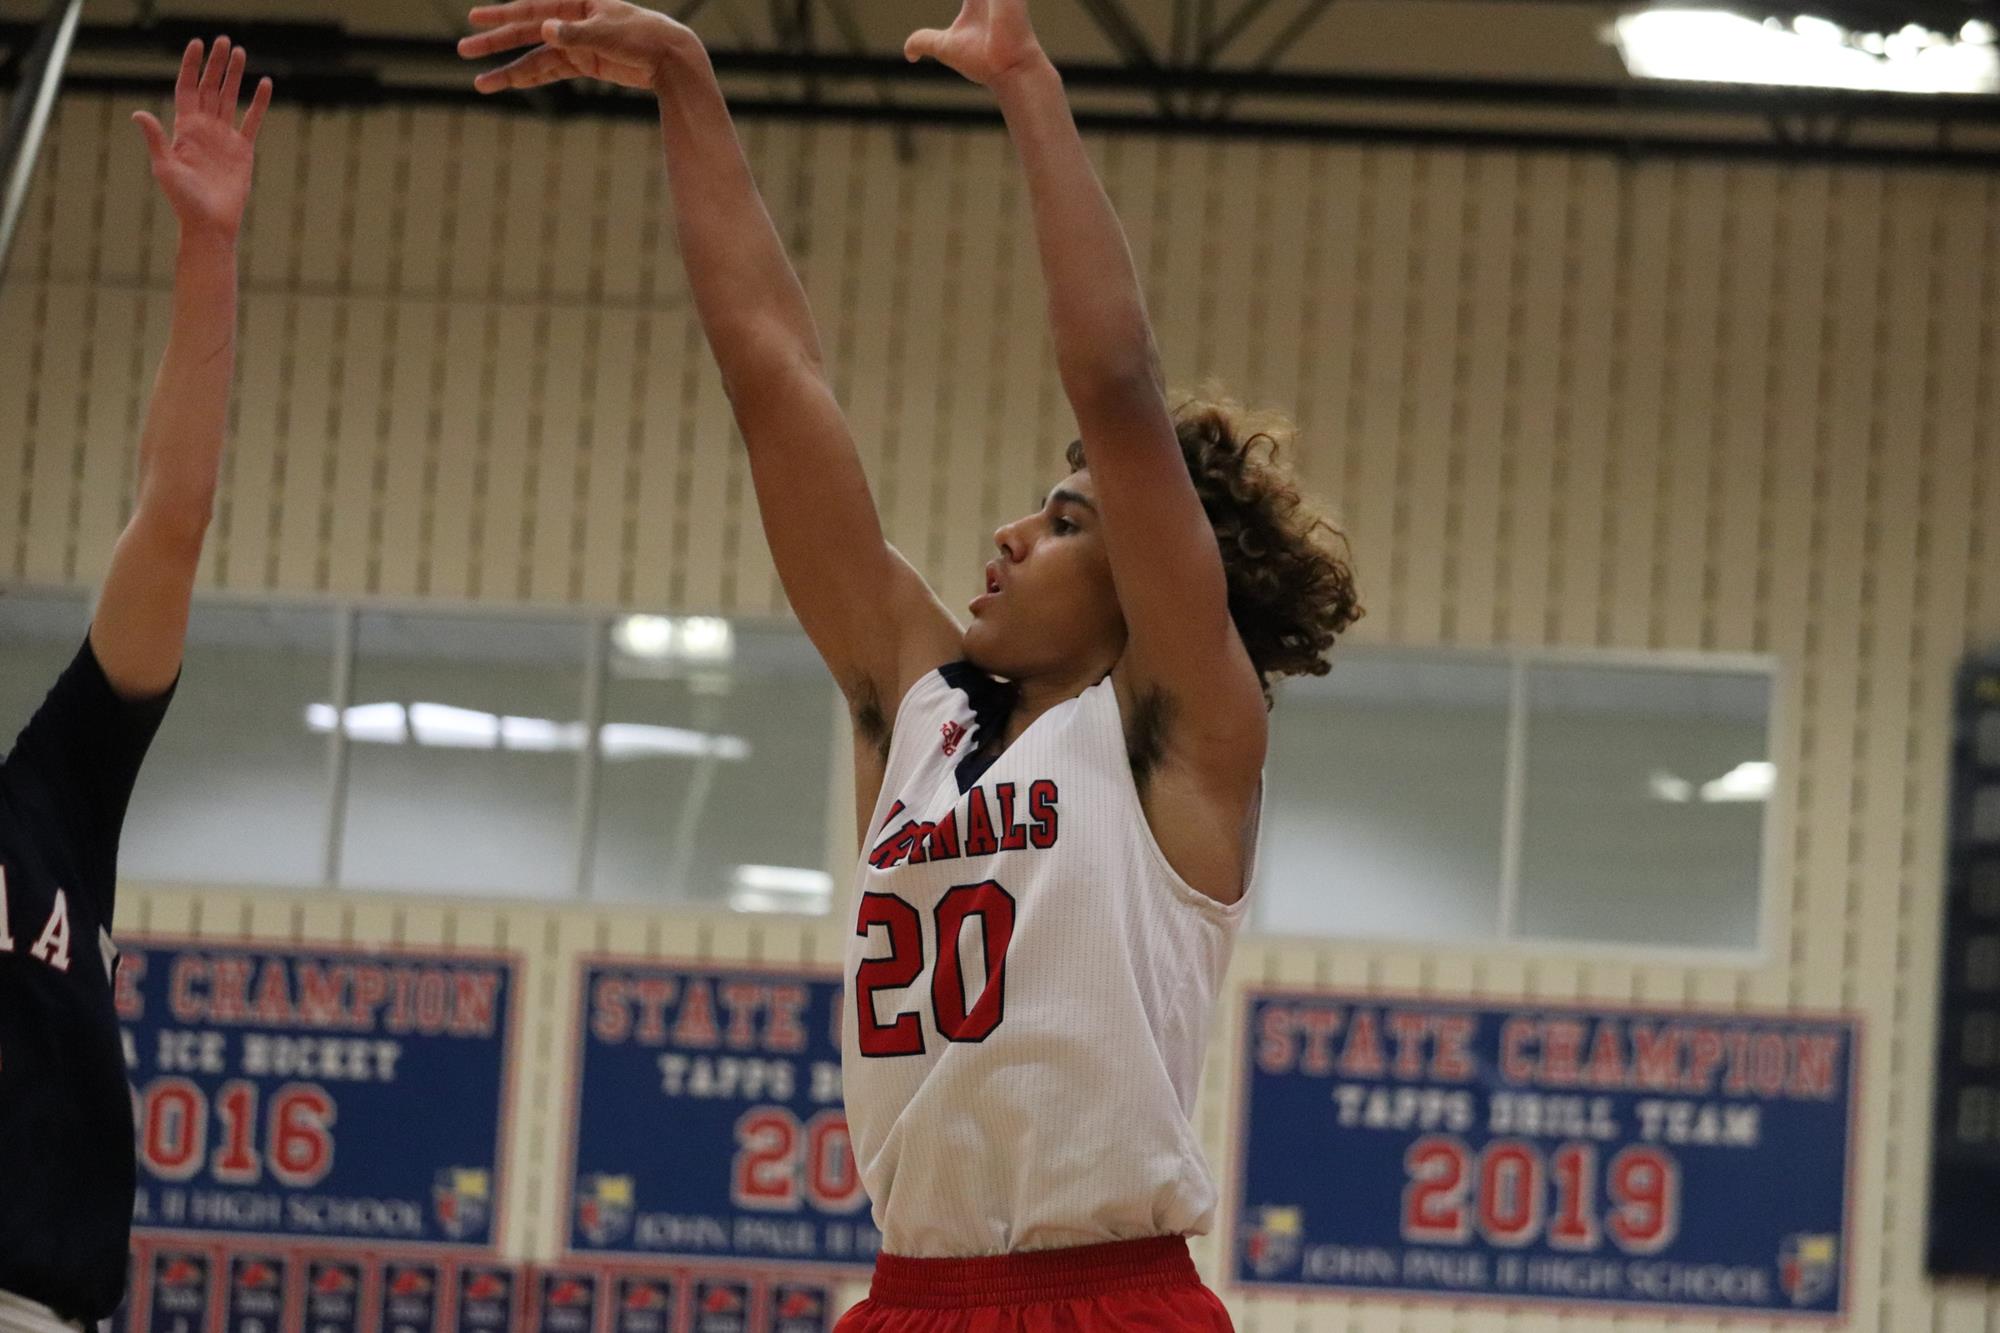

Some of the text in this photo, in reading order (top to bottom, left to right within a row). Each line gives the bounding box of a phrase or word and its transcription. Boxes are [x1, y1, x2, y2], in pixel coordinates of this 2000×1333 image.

[169, 956, 498, 1038] CHAMPION
[855, 879, 1017, 1058] 20
[157, 1029, 226, 1074] ICE
[243, 1033, 400, 1082] HOCKEY
[591, 977, 808, 1053] STATE
[1256, 1005, 1838, 1098] STATE CHAMPION
[131, 1076, 337, 1187] 016
[1634, 1098, 1761, 1147] TEAM
[1401, 1133, 1681, 1256] 2019
